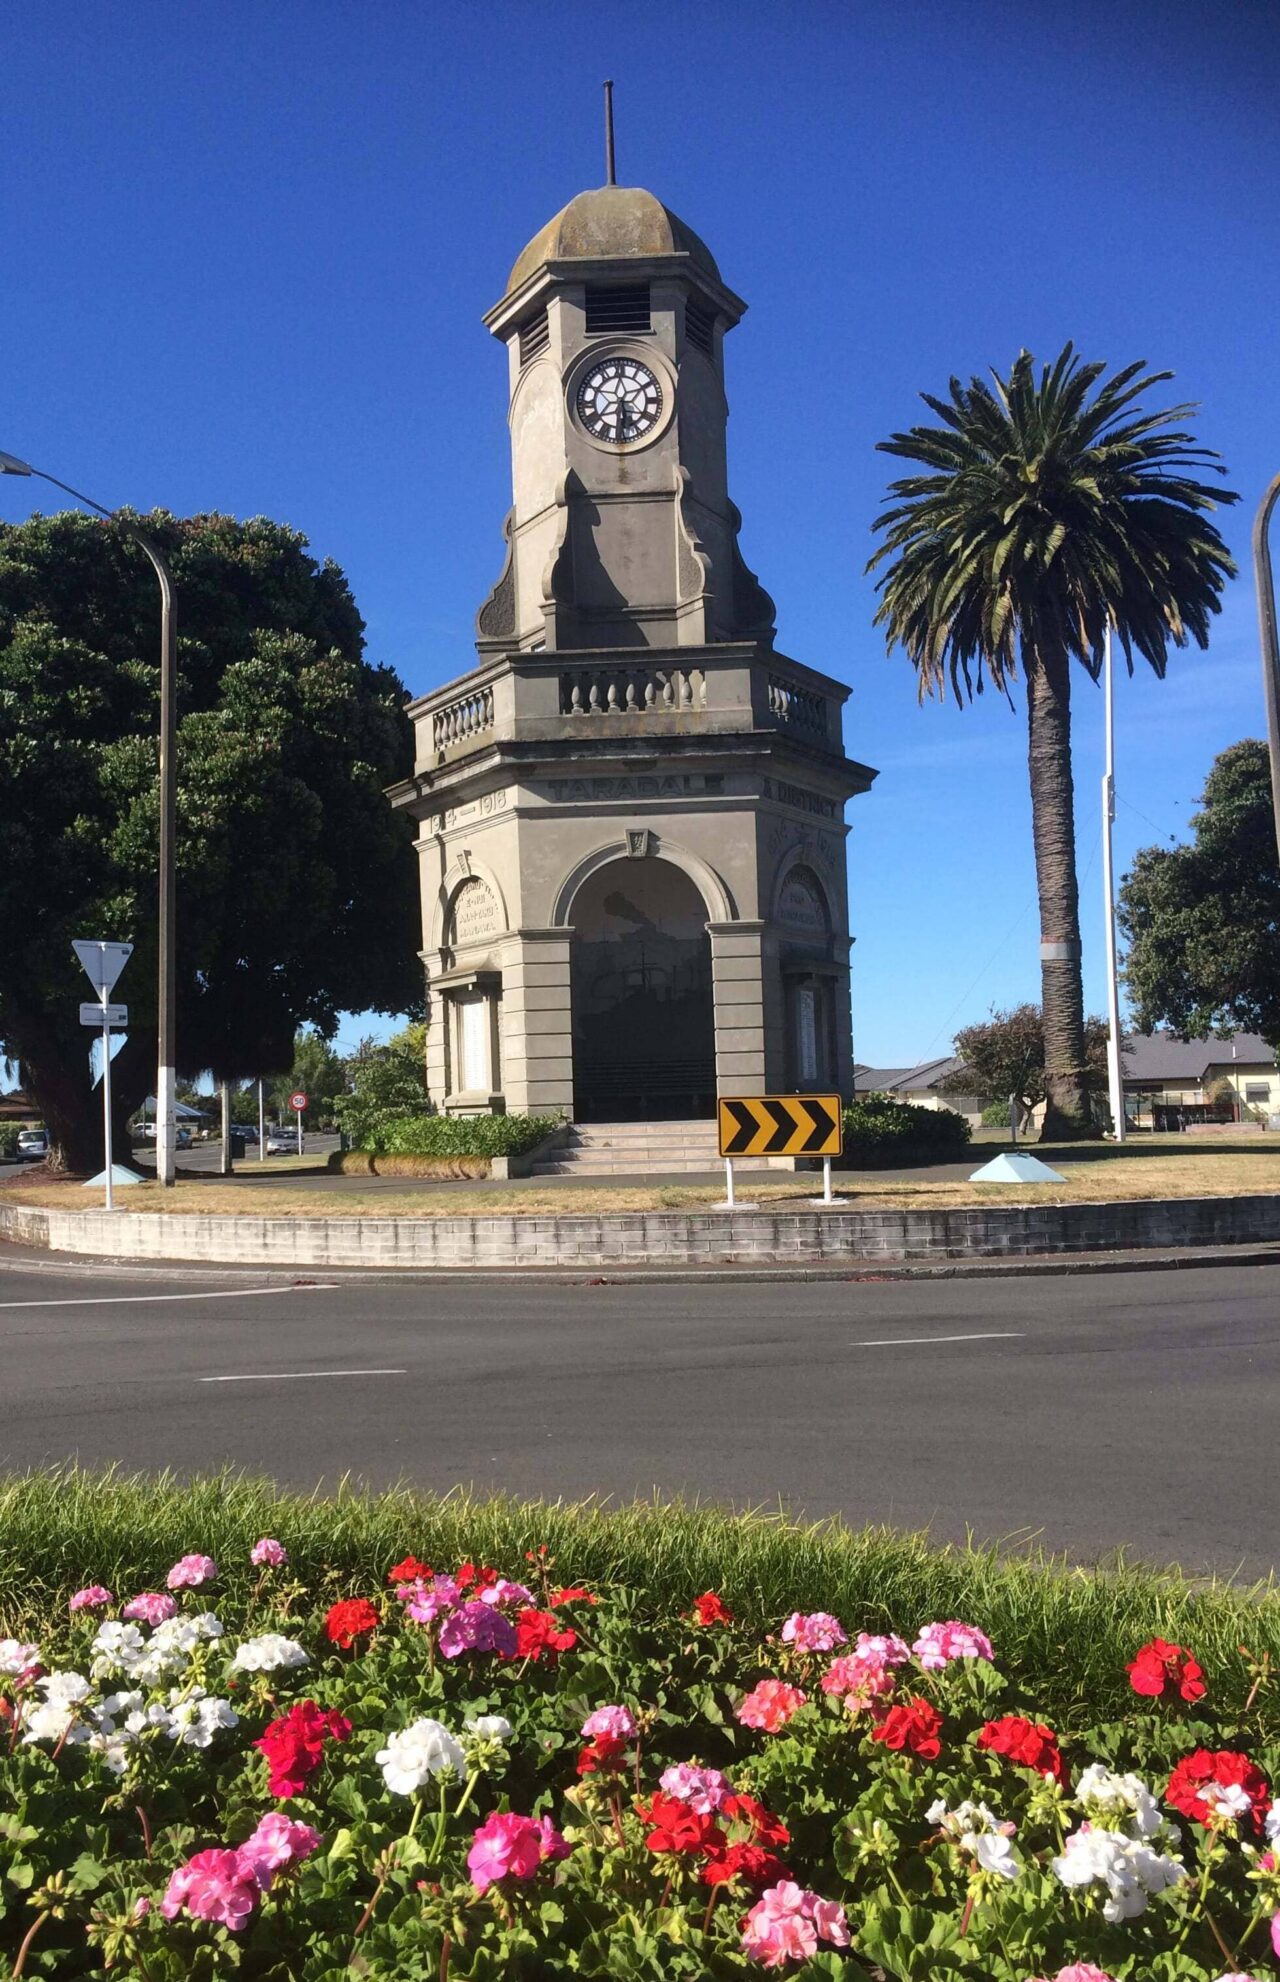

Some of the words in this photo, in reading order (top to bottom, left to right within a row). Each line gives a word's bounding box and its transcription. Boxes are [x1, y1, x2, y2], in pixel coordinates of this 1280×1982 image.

[548, 774, 724, 800] TARADALE
[430, 808, 457, 834] 194
[295, 1097, 304, 1105] 50
